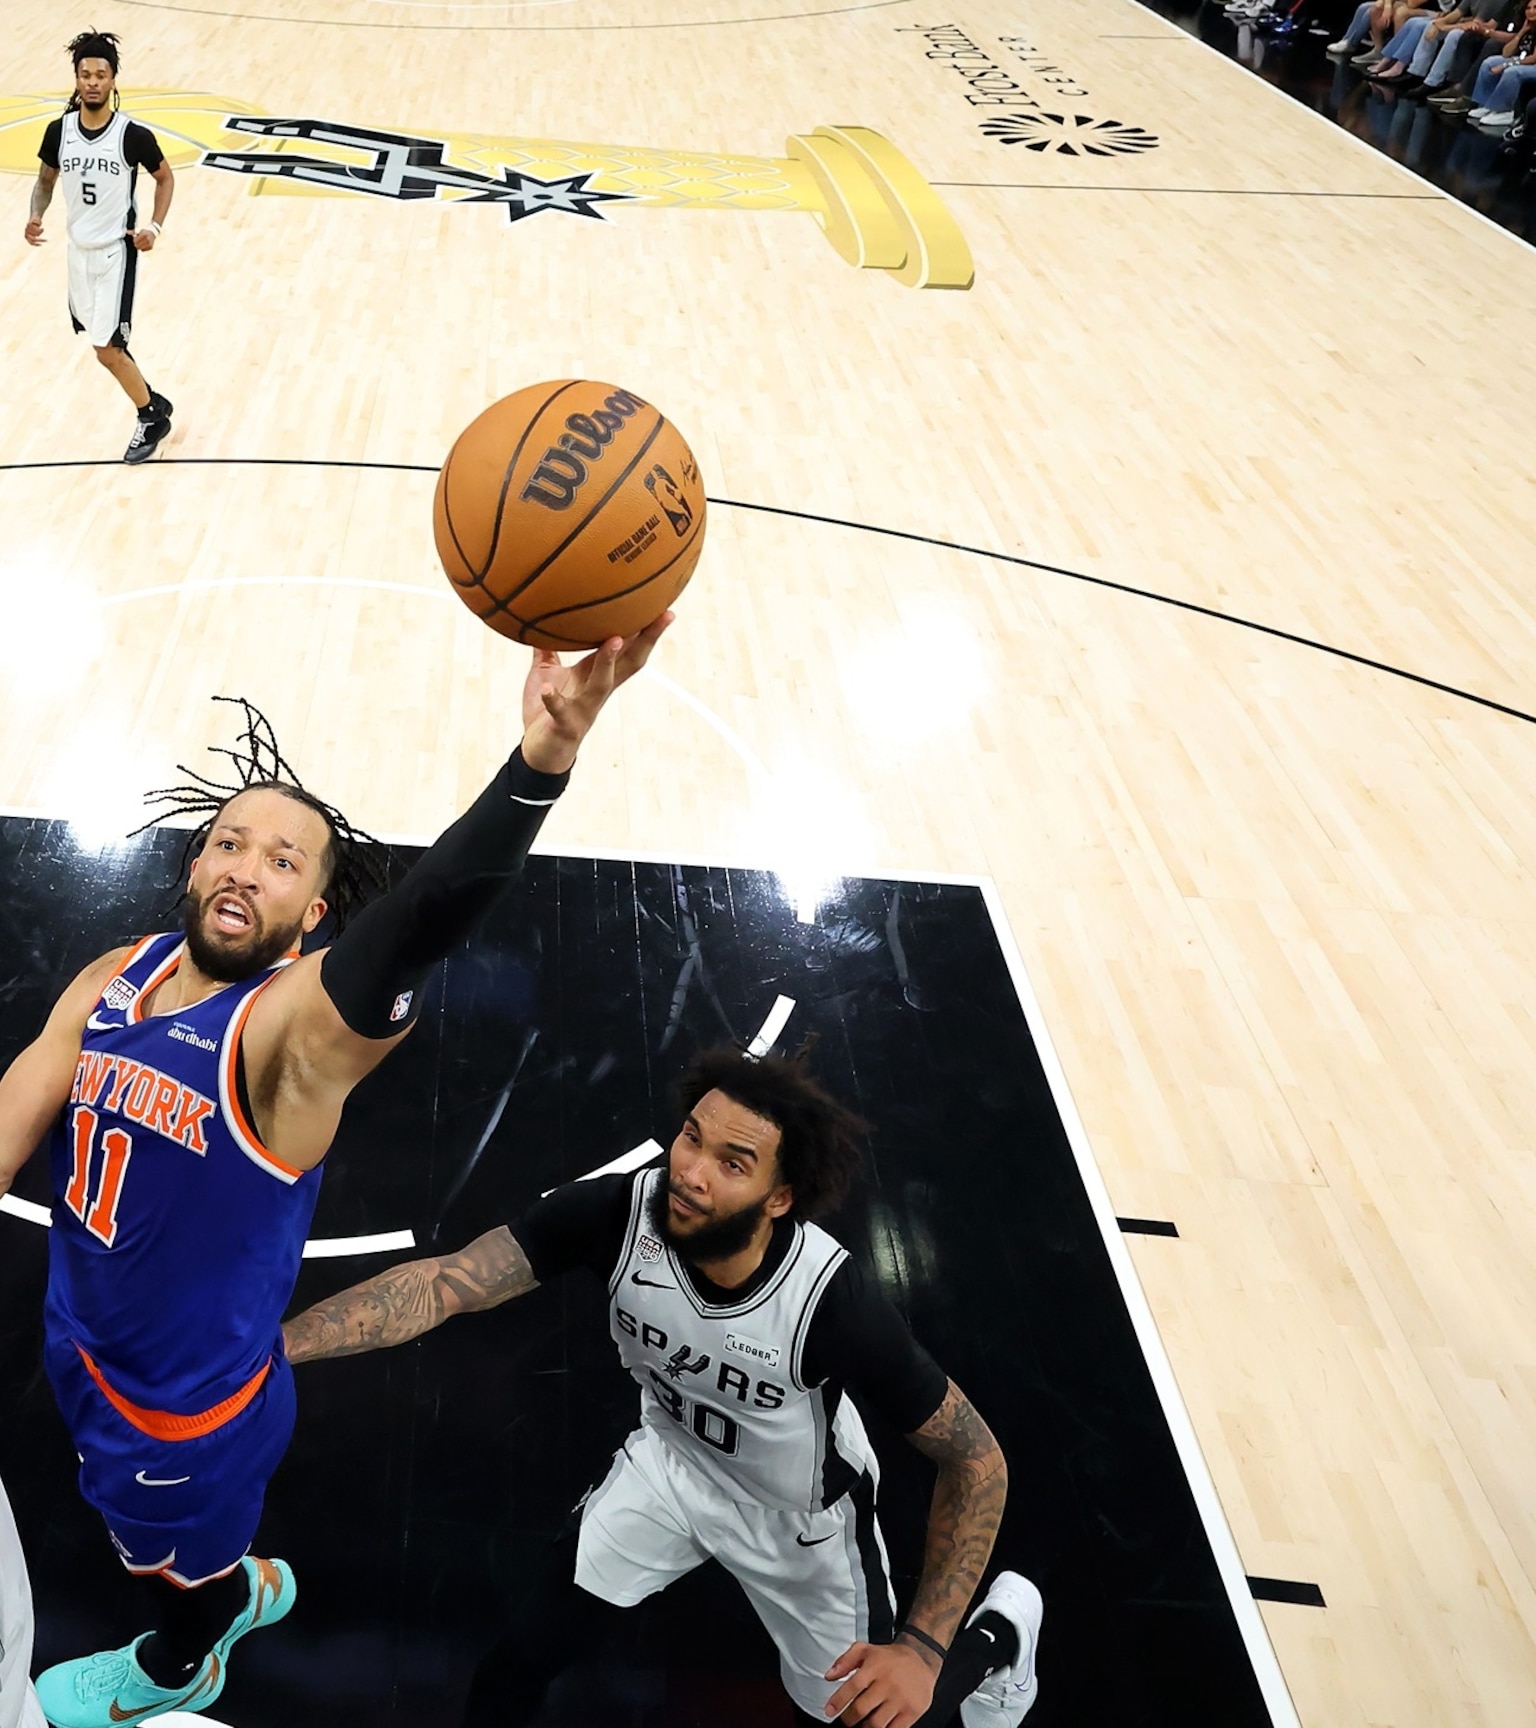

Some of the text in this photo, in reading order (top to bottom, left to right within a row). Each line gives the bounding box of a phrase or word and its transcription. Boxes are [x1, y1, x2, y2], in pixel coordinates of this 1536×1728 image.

[62, 157, 121, 177] SPURS
[82, 182, 97, 205] 5
[520, 388, 650, 511] Wilson
[167, 1027, 185, 1041] abu
[185, 1032, 218, 1052] dhabi
[103, 1053, 217, 1158] YORK
[65, 1105, 131, 1248] 11
[616, 1307, 785, 1409] SPURS
[732, 1340, 772, 1361] LEDGER
